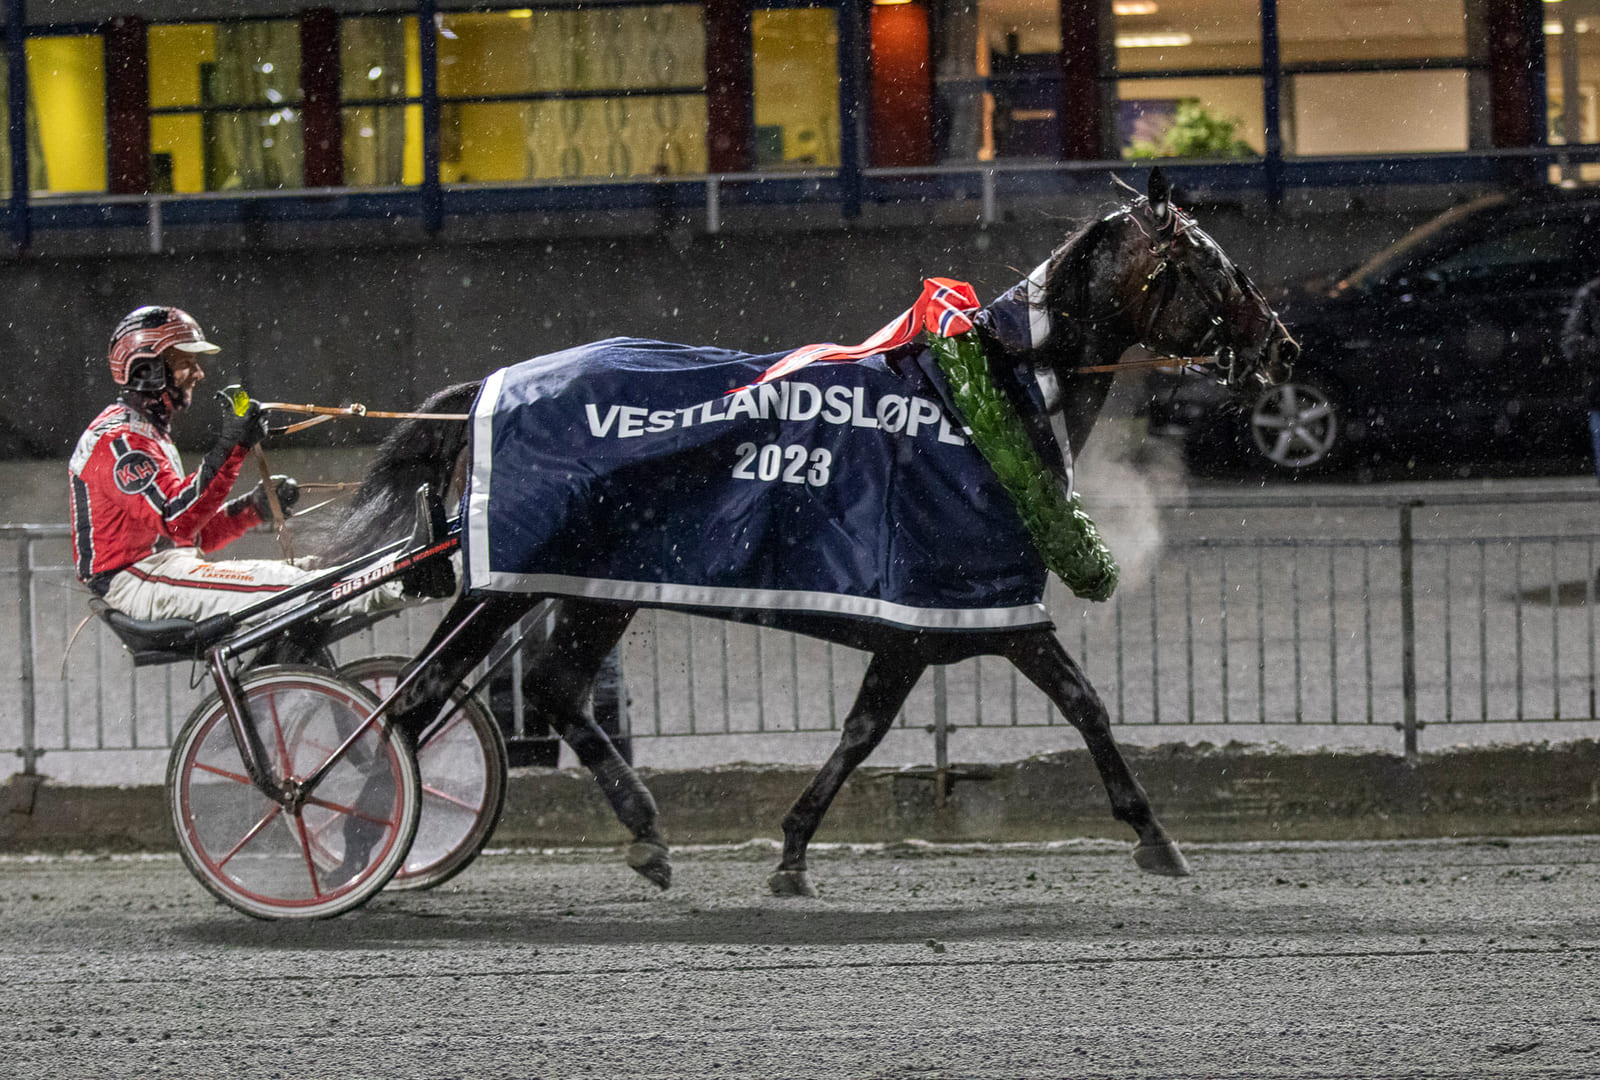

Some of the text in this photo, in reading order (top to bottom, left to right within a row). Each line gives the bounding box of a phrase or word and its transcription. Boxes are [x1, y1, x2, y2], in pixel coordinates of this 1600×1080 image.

[117, 461, 155, 487] KH
[732, 442, 832, 487] 2023
[331, 562, 396, 600] CUSTOM
